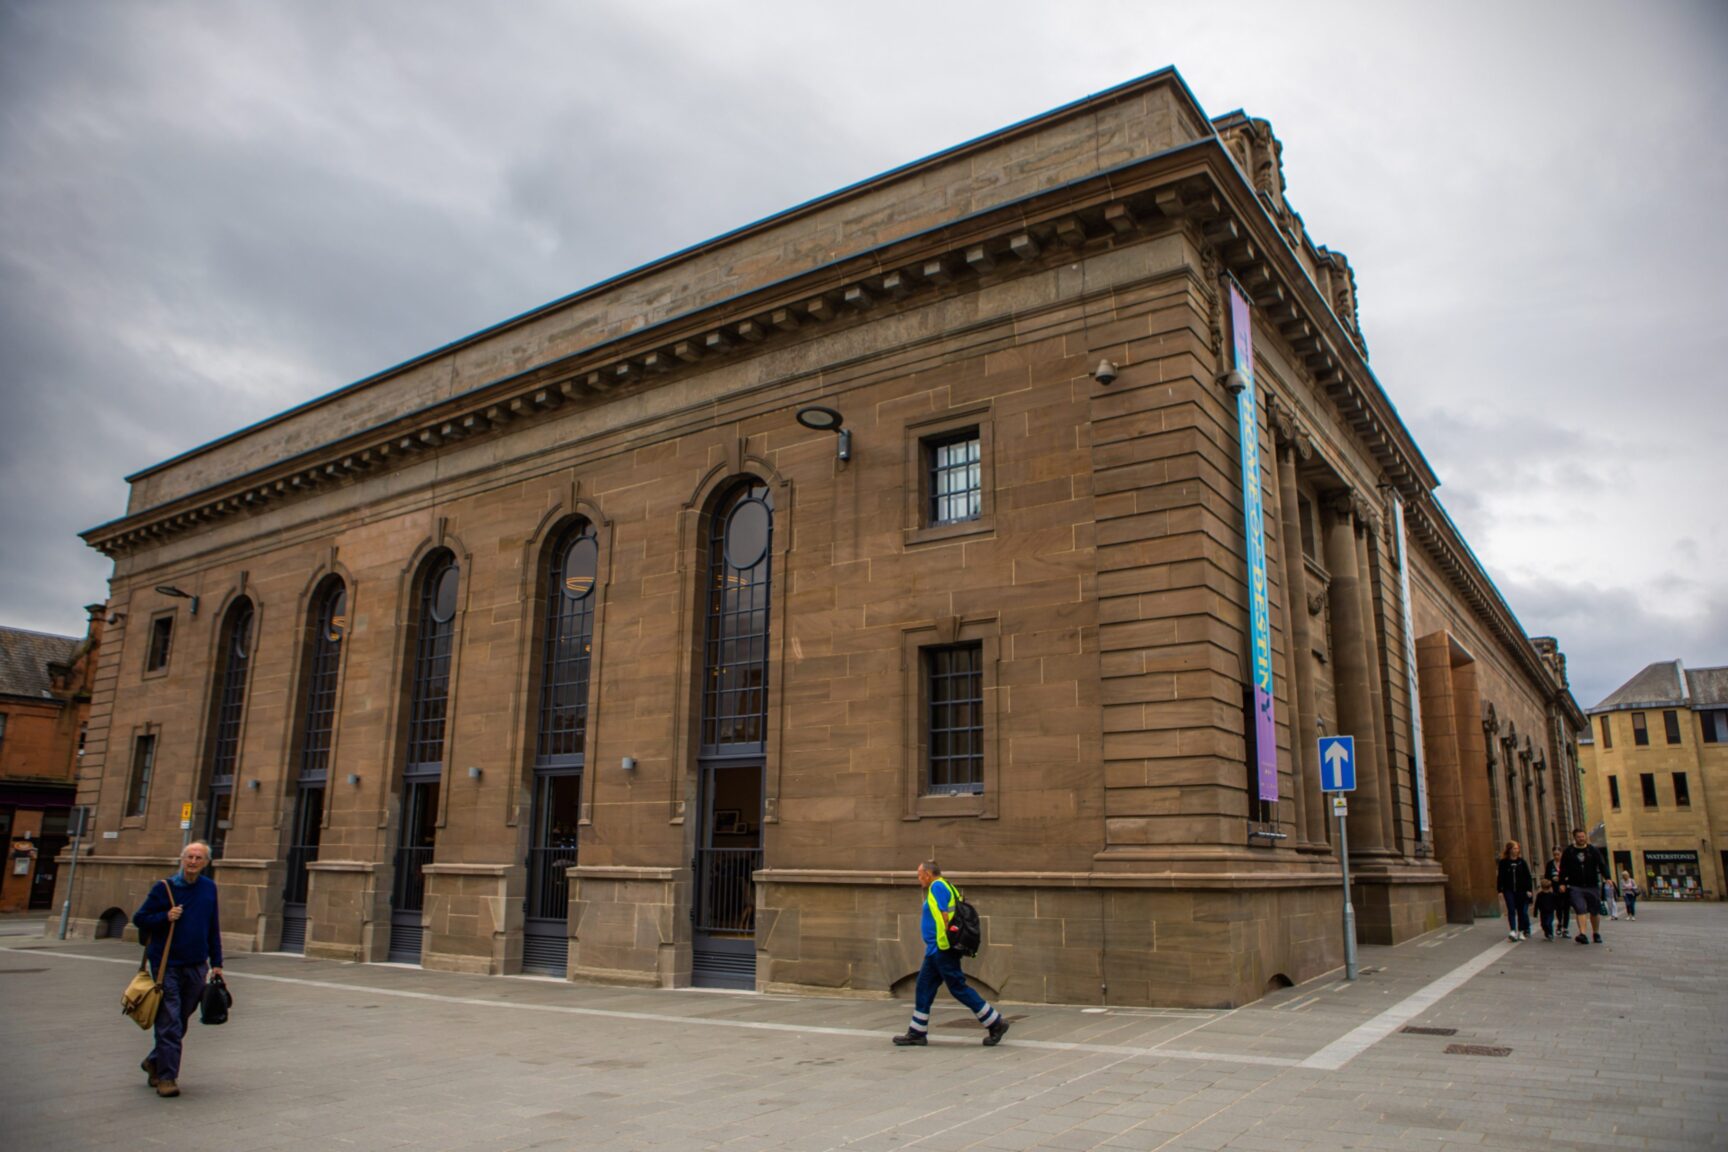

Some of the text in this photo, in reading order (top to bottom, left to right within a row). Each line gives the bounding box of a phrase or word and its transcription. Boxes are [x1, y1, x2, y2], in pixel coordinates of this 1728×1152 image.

[1243, 397, 1257, 502] HOME
[1249, 508, 1261, 559] OF
[1253, 564, 1271, 722] DESTINY
